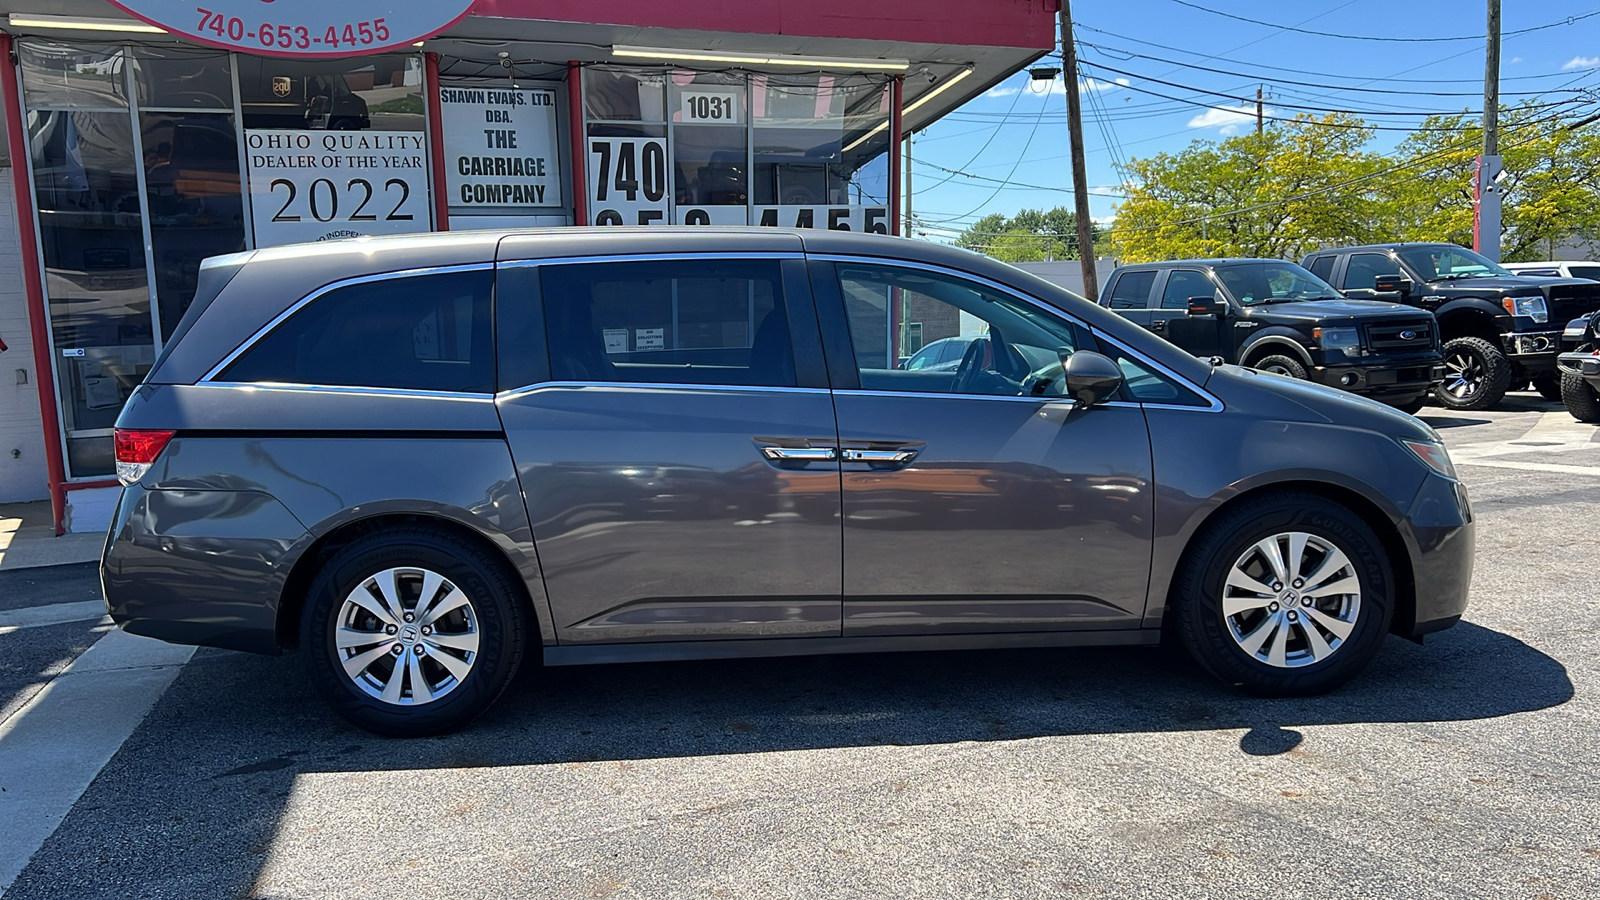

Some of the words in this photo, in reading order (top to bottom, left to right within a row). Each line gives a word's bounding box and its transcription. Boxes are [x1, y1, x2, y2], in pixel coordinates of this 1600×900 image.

[197, 7, 390, 49] 740-653-4455
[441, 89, 485, 104] SHAWN
[531, 93, 554, 106] LTD.
[687, 96, 732, 119] 1031
[485, 109, 513, 123] DBA.
[249, 134, 311, 149] OHIO
[322, 135, 423, 152] QUALITY
[484, 129, 517, 149] THE
[253, 155, 318, 168] DEALER
[321, 155, 342, 168] OF
[346, 156, 378, 168] THE
[381, 156, 422, 168] YEAR
[458, 156, 546, 177] CARRIAGE
[592, 141, 665, 202] 740
[270, 178, 414, 222] 2022
[461, 183, 546, 203] COMPANY
[326, 229, 363, 240] INDEPEN
